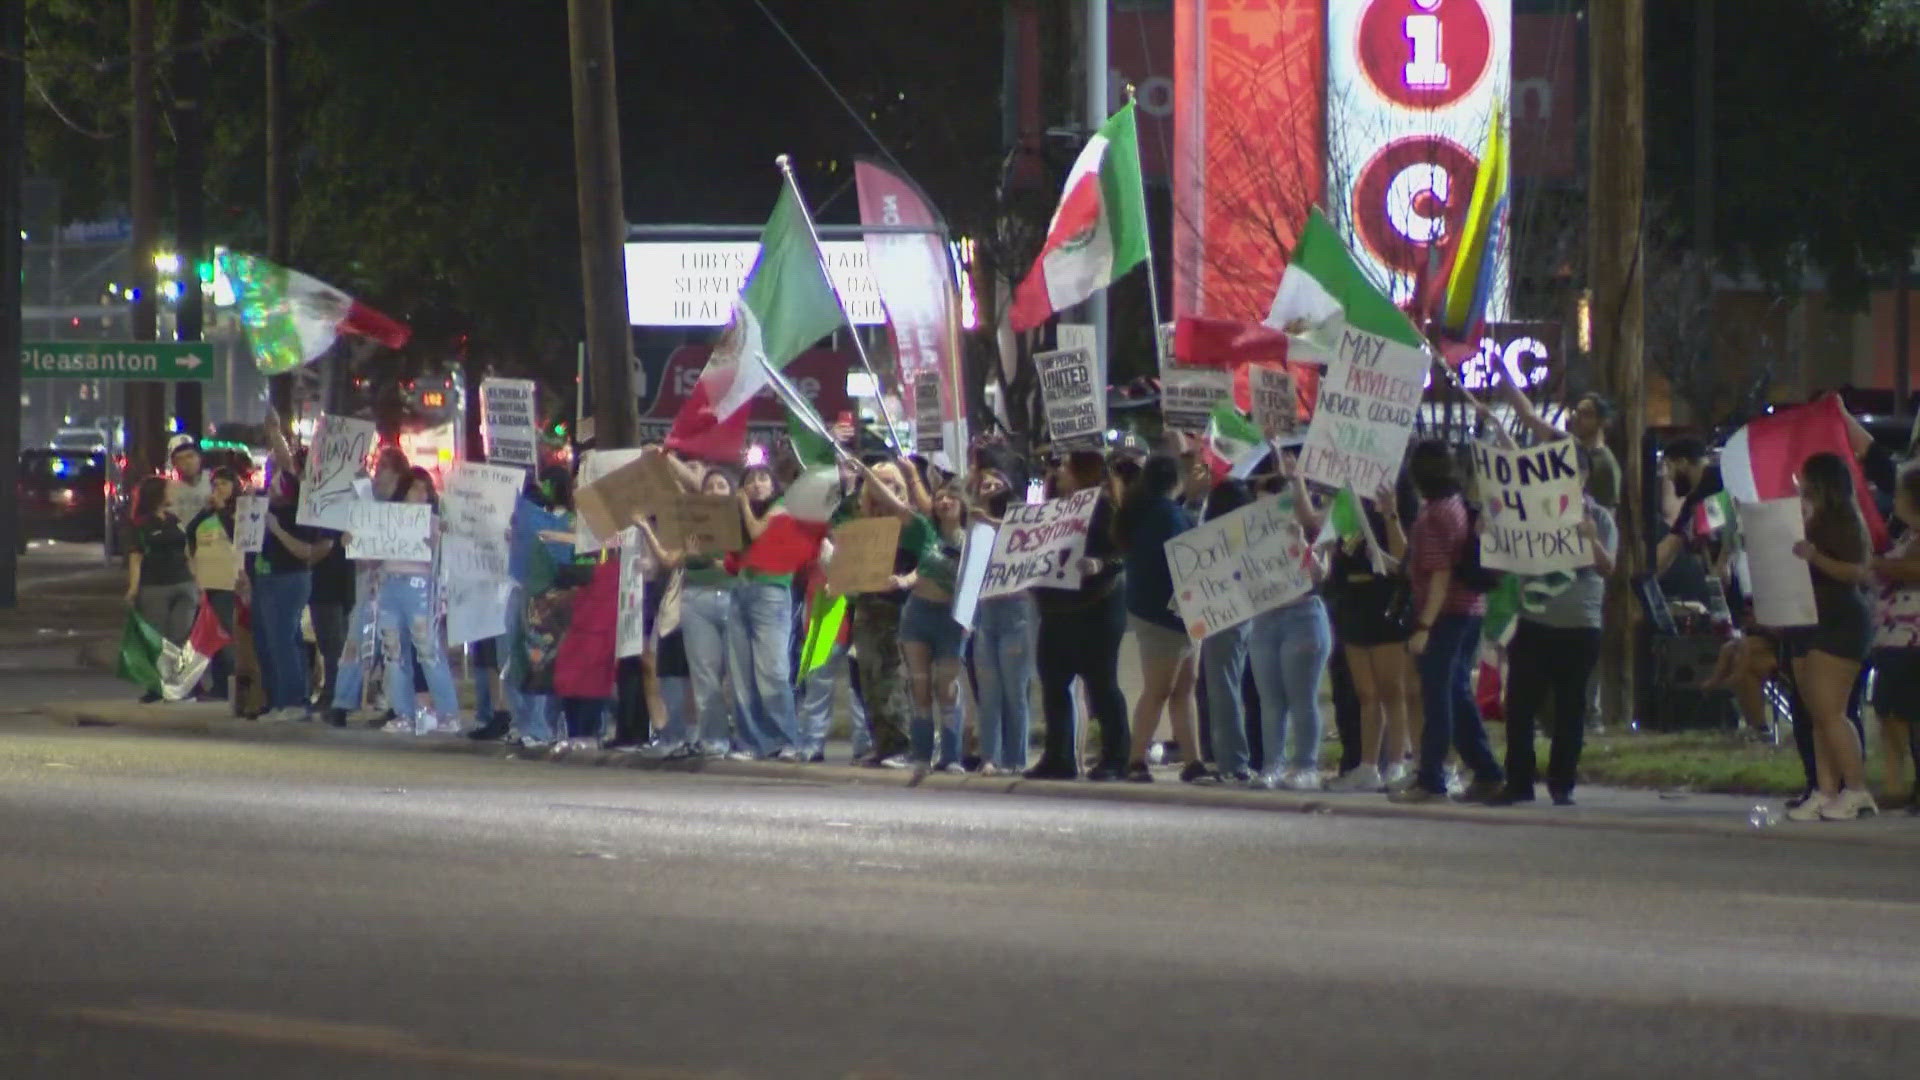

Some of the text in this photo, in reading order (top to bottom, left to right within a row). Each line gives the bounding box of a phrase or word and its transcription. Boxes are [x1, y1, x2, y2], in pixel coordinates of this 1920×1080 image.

[1339, 330, 1386, 367] MAY
[1044, 365, 1088, 388] UNITED
[1318, 391, 1360, 419] NEVER
[1368, 402, 1411, 427] CLOUD
[1335, 421, 1377, 449] YOUR
[1304, 446, 1391, 488] EMPATHY
[1473, 443, 1576, 486] HONK
[1005, 490, 1095, 525] ICE STOP
[1502, 489, 1527, 521] 4
[1485, 526, 1586, 558] SUPPORT
